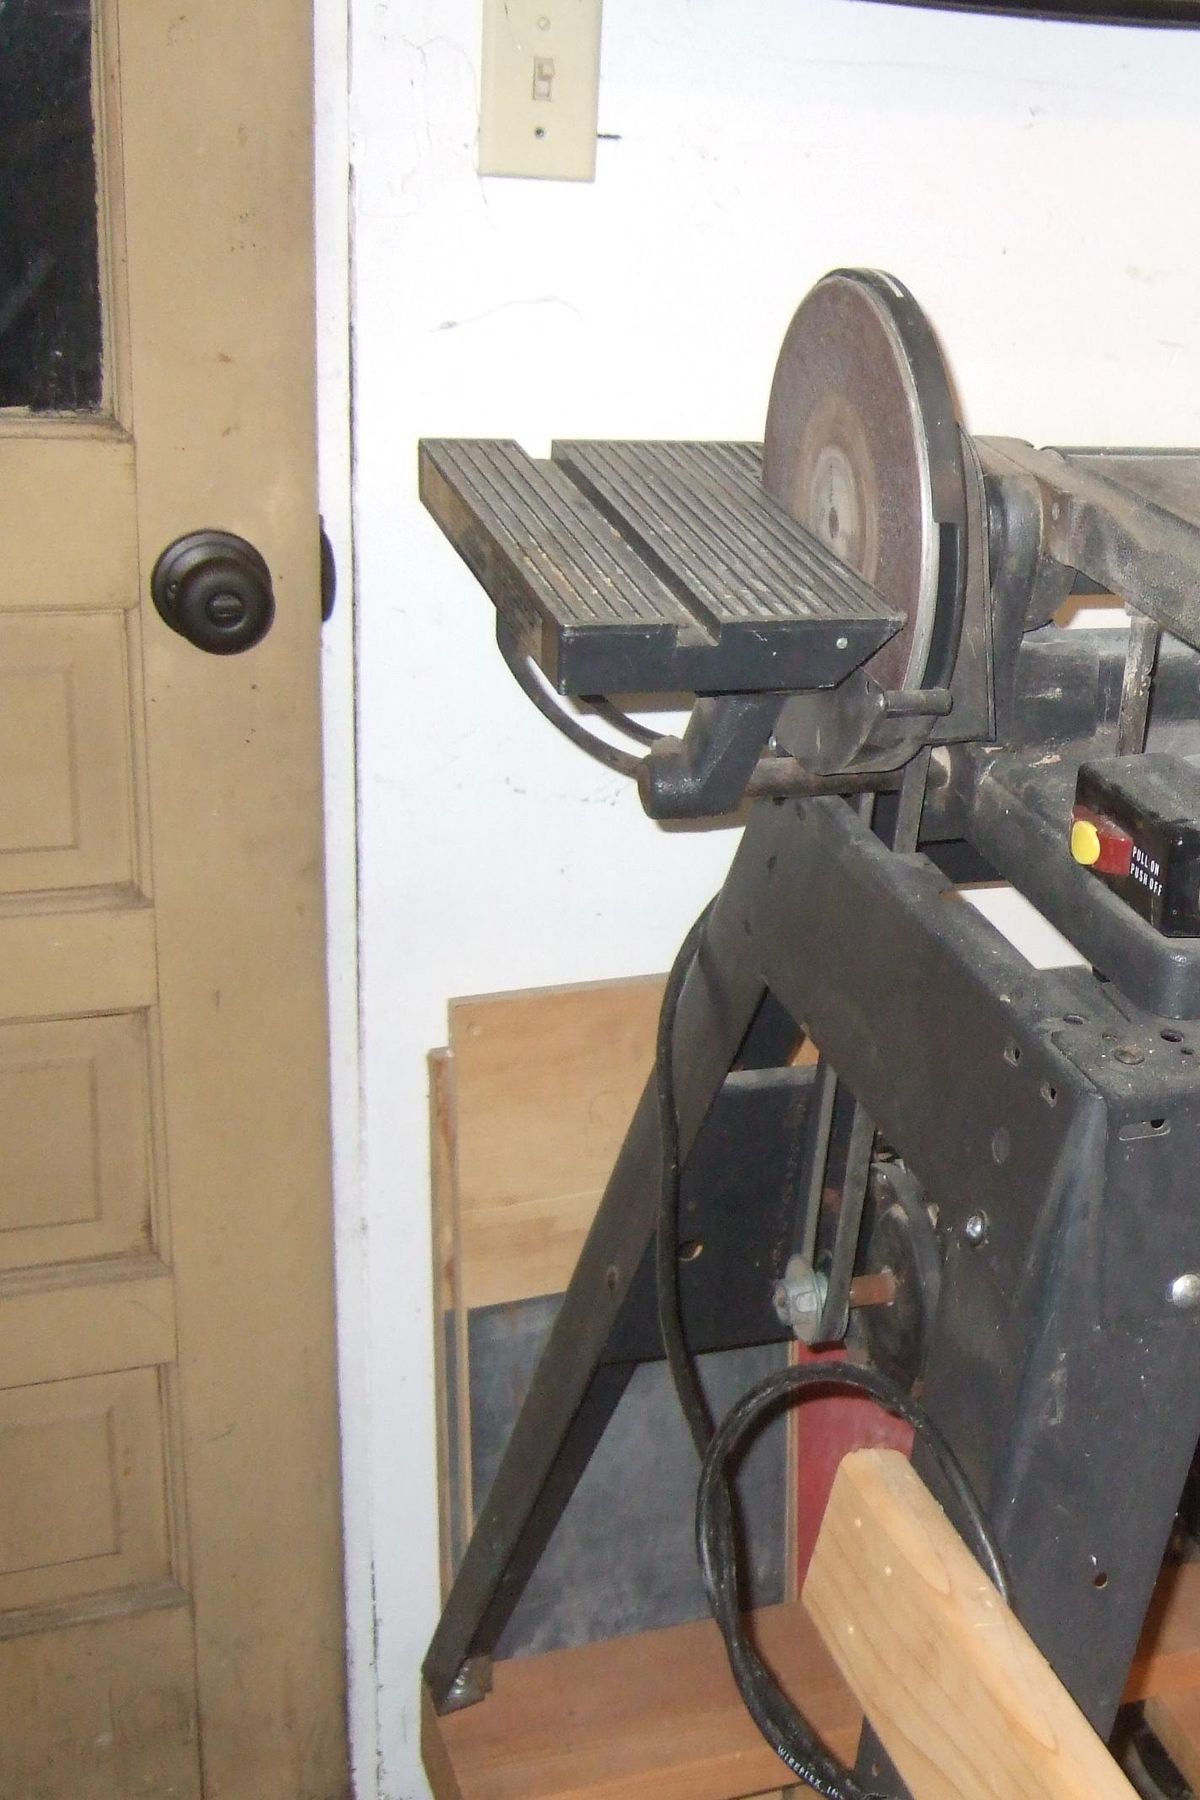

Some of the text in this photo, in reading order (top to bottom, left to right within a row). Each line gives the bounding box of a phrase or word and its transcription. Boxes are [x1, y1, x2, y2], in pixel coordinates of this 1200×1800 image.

[1132, 846, 1160, 877] PULL ON
[1130, 863, 1163, 897] PUSH OFF
